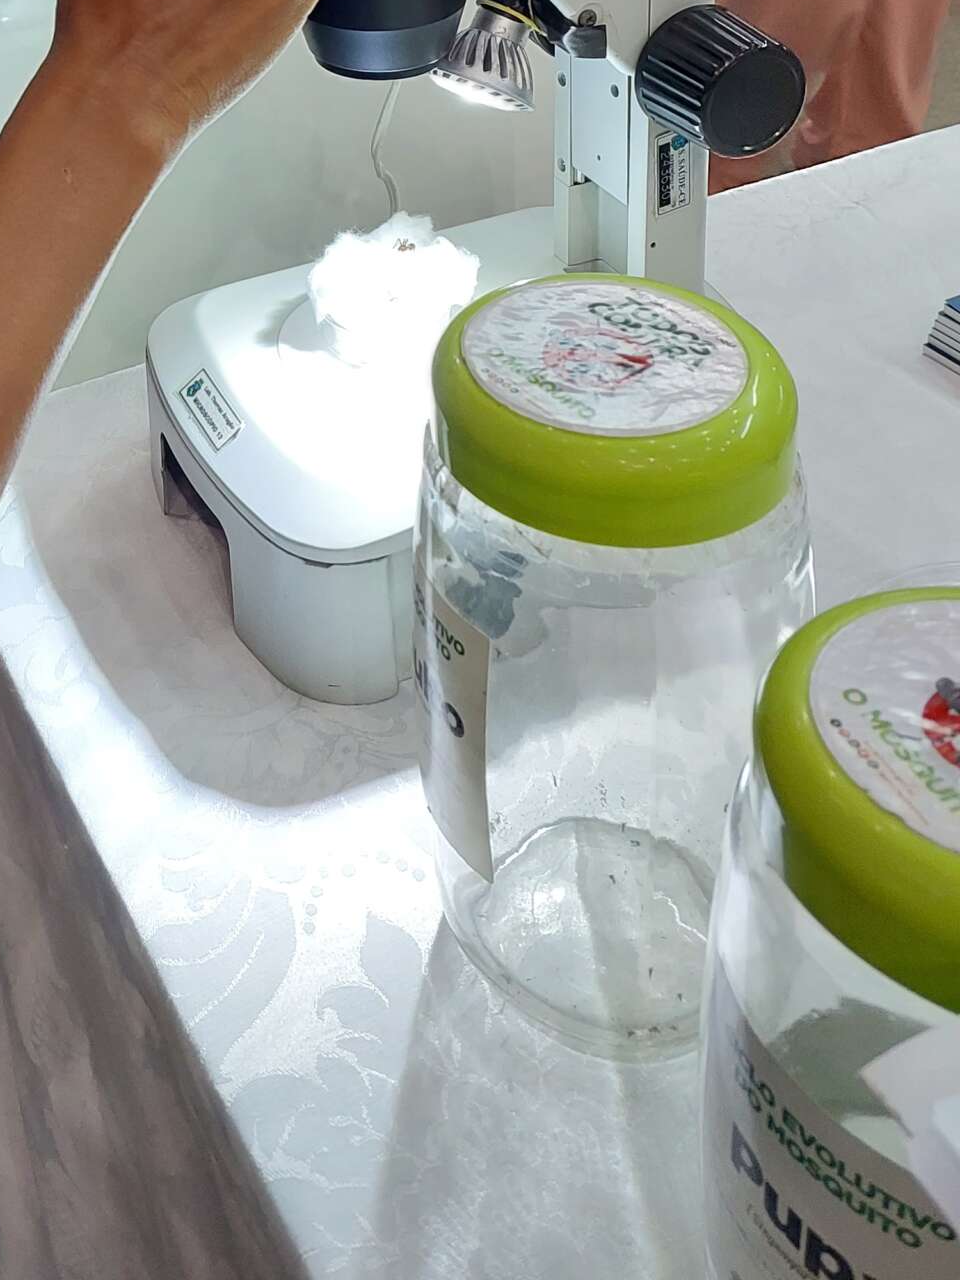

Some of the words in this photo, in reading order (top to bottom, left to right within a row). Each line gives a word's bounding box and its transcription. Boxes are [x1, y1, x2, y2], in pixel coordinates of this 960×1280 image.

[842, 687, 868, 706] O
[730, 1121, 881, 1280] Pup
[767, 1111, 922, 1249] MOSQUITO
[782, 1107, 958, 1242] EVOLUTIVO
